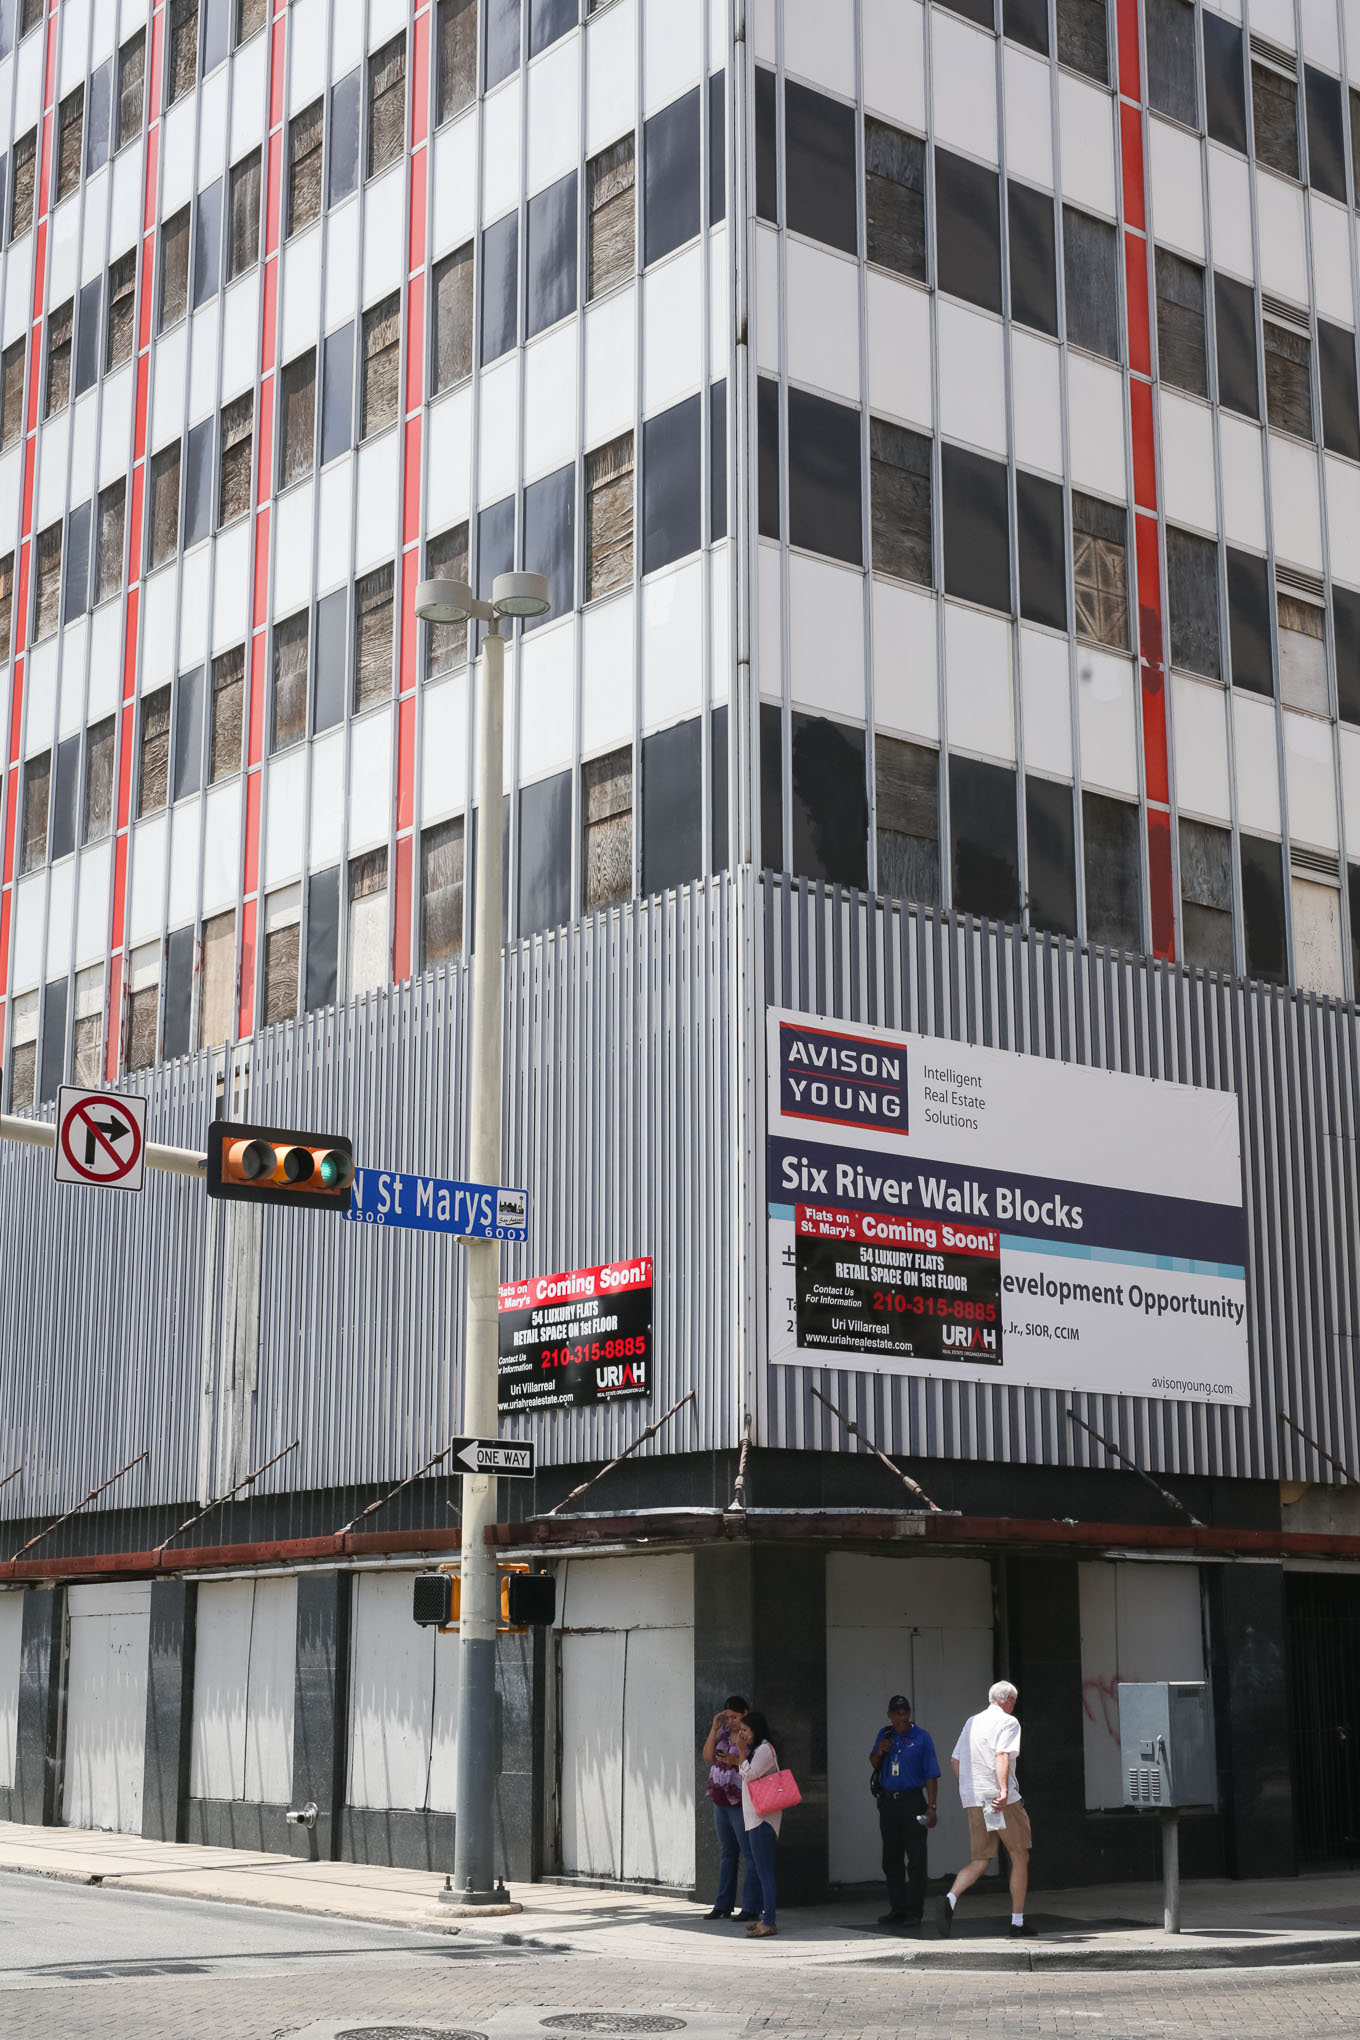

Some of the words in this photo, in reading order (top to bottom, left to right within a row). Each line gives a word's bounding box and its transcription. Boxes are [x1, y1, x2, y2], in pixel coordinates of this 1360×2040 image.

[788, 1041, 899, 1080] AVISON
[924, 1065, 982, 1087] Intelligent
[788, 1077, 900, 1117] YOUNG
[925, 1087, 948, 1104] Real
[951, 1092, 985, 1109] Estate
[925, 1109, 978, 1130] Solutions
[352, 1171, 364, 1209] N
[377, 1174, 403, 1214] St
[416, 1179, 492, 1234] Marys
[781, 1156, 828, 1194] Six
[836, 1164, 912, 1204] River
[918, 1176, 989, 1216] Walk
[996, 1187, 1083, 1230] Blocks
[356, 1210, 385, 1224] 500
[806, 1208, 833, 1223] Flats
[836, 1214, 849, 1224] on
[485, 1228, 516, 1240] 600
[801, 1220, 816, 1233] St.
[819, 1223, 855, 1238] Mary's
[862, 1217, 937, 1248] Coming
[942, 1226, 994, 1252] Soon!
[860, 1247, 873, 1263] 54
[875, 1249, 912, 1267] LUXURY
[915, 1254, 944, 1271] FLATS
[536, 1274, 595, 1300] Coming
[600, 1261, 646, 1289] Soon!
[835, 1262, 869, 1281] RETAIL
[871, 1268, 902, 1285] SPACE
[904, 1271, 918, 1286] ON
[920, 1273, 936, 1288] 1st
[938, 1274, 968, 1292] FLOOR
[517, 1283, 528, 1294] on
[813, 1284, 842, 1296] Contact
[845, 1287, 854, 1297] Us
[1002, 1272, 1124, 1306] evelopment
[1128, 1284, 1244, 1326] Opportunity
[504, 1295, 531, 1309] Mary's
[805, 1294, 819, 1304] For
[820, 1295, 862, 1308] Information
[873, 1291, 996, 1322] 210-315-8885
[531, 1311, 543, 1326] 54
[544, 1304, 576, 1324] LUXURY
[576, 1300, 599, 1317] FLATS
[513, 1327, 539, 1347] RETAIL
[540, 1323, 567, 1343] SPACE
[568, 1322, 577, 1338] ON
[580, 1319, 592, 1336] 1st
[593, 1315, 618, 1333] FLOOR
[831, 1318, 847, 1331] Uri
[848, 1319, 890, 1335] Villarreal
[1009, 1321, 1023, 1337] Jr.,
[1025, 1323, 1052, 1340] SIOR,
[1054, 1326, 1080, 1341] CCIM
[805, 1333, 913, 1351] www.uriahrealestate.com
[942, 1325, 997, 1350] URIAH
[498, 1354, 518, 1365] Contact
[519, 1353, 527, 1362] Us
[541, 1336, 646, 1369] 210-315-8885
[502, 1363, 533, 1374] Information
[596, 1361, 646, 1388] URIAH
[510, 1384, 521, 1396] Uri
[521, 1378, 556, 1394] Villarreal
[1151, 1376, 1233, 1396] avisonyoung.com
[498, 1393, 574, 1411] ww.uriahrealestate.com
[477, 1450, 499, 1465] ONE
[504, 1452, 527, 1466] WAY
